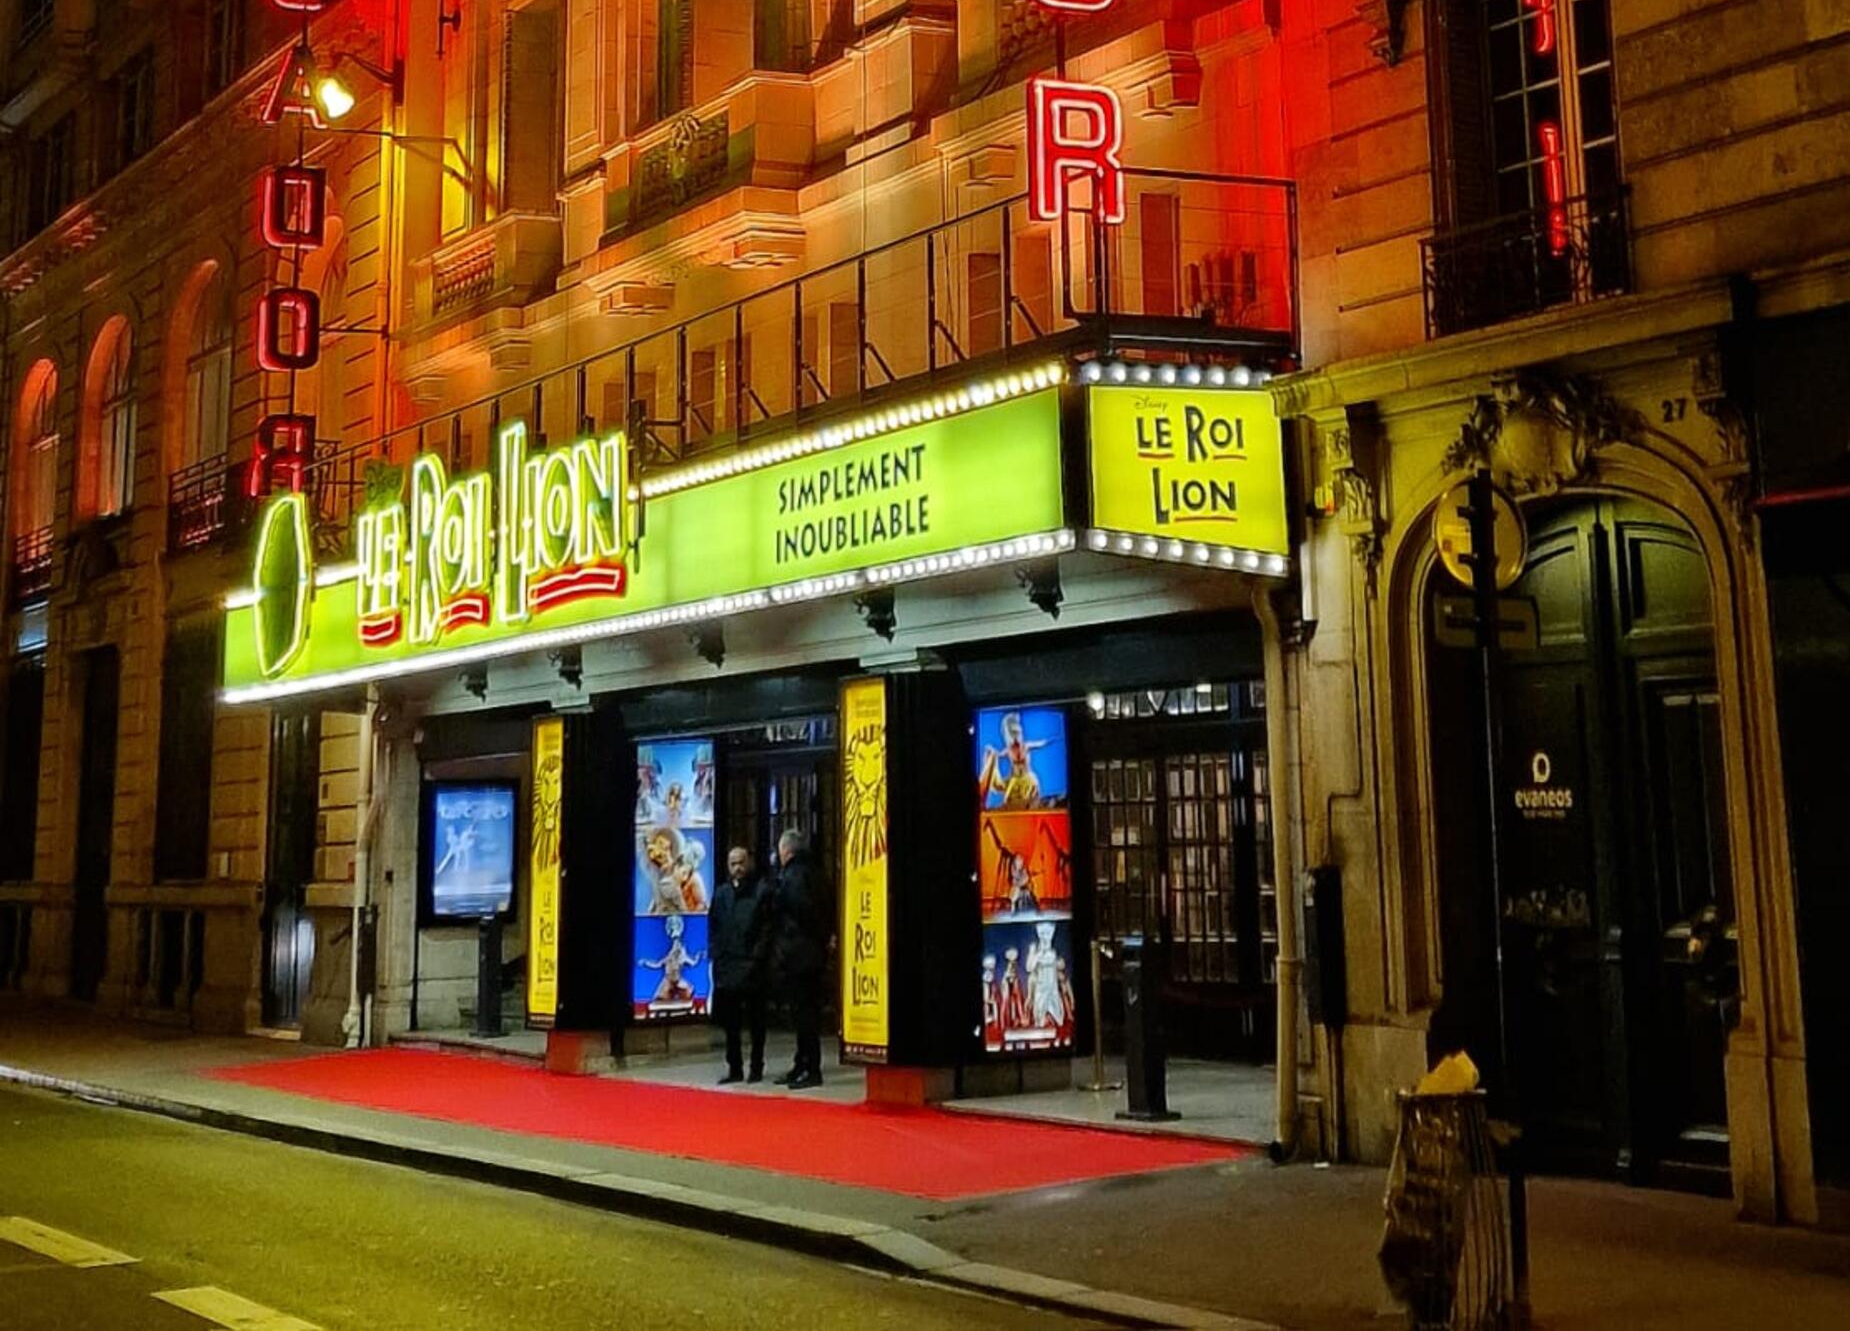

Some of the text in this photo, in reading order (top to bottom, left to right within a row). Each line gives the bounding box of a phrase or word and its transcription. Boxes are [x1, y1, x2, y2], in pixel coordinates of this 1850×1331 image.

[1136, 405, 1244, 462] LE ROI
[1662, 398, 1686, 422] 27
[779, 444, 925, 515] SIMPLEMENT
[1152, 467, 1236, 524] LION
[357, 421, 627, 645] LE ROI LION
[776, 494, 929, 565] INOUBLIABLE
[1515, 790, 1573, 808] evaneos
[860, 891, 871, 913] LE
[855, 922, 876, 962] ROI
[852, 966, 879, 1006] LION
